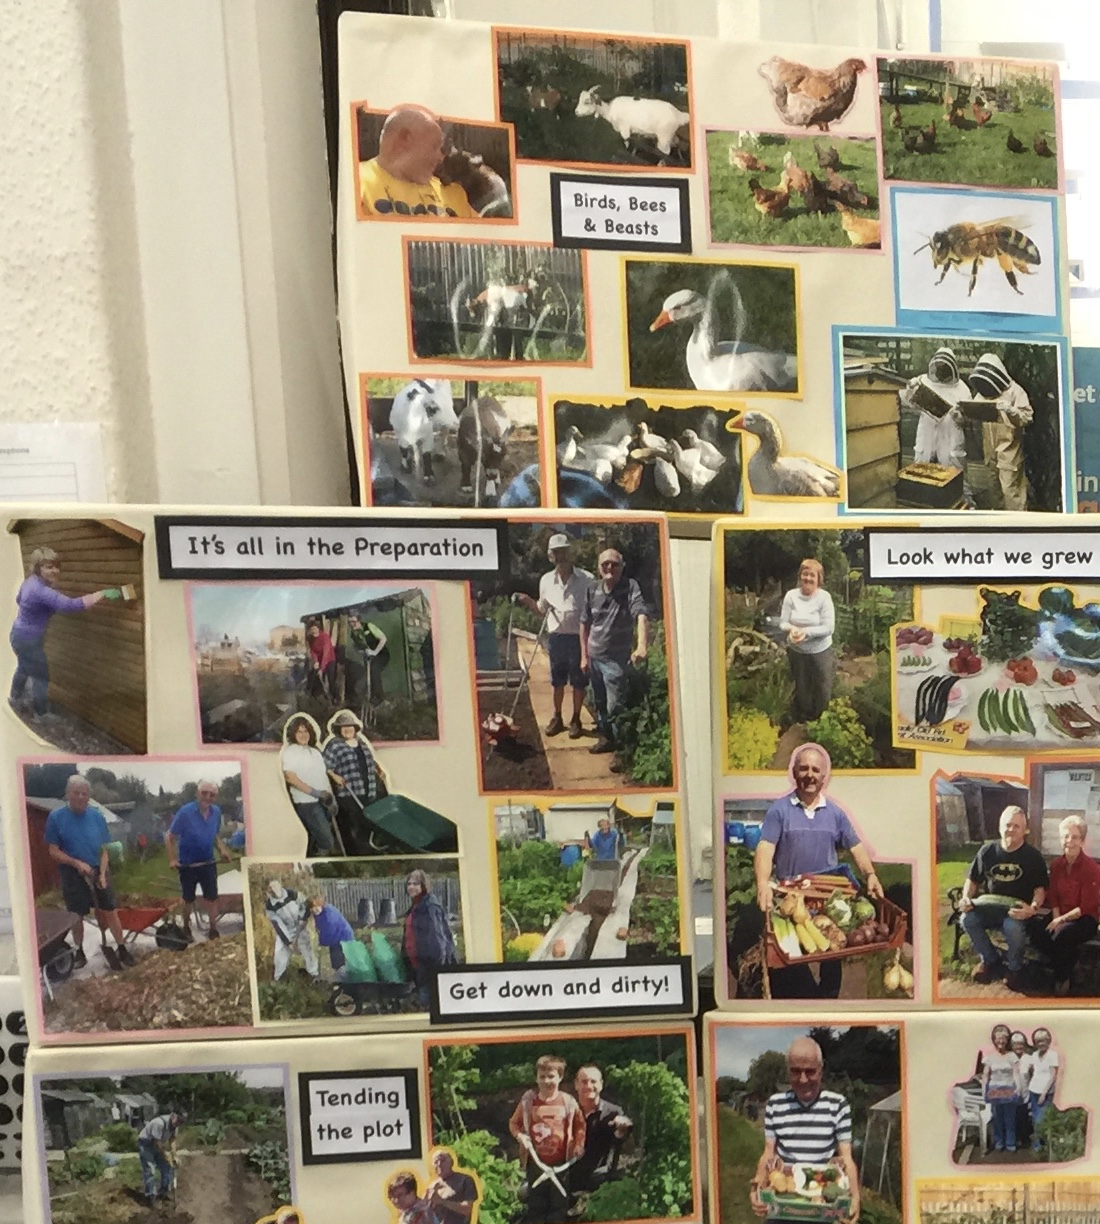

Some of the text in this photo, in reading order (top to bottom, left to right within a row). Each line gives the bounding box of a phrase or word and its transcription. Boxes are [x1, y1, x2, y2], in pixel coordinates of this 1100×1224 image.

[574, 193, 666, 212] Birds, Bees
[584, 218, 658, 235] & Beasts
[189, 534, 483, 561] It's all in the Preparation
[887, 548, 1093, 569] Look what we grew
[450, 975, 669, 1000] Get down and dirty!
[316, 1087, 399, 1108] Tending
[317, 1119, 403, 1143] the plot
